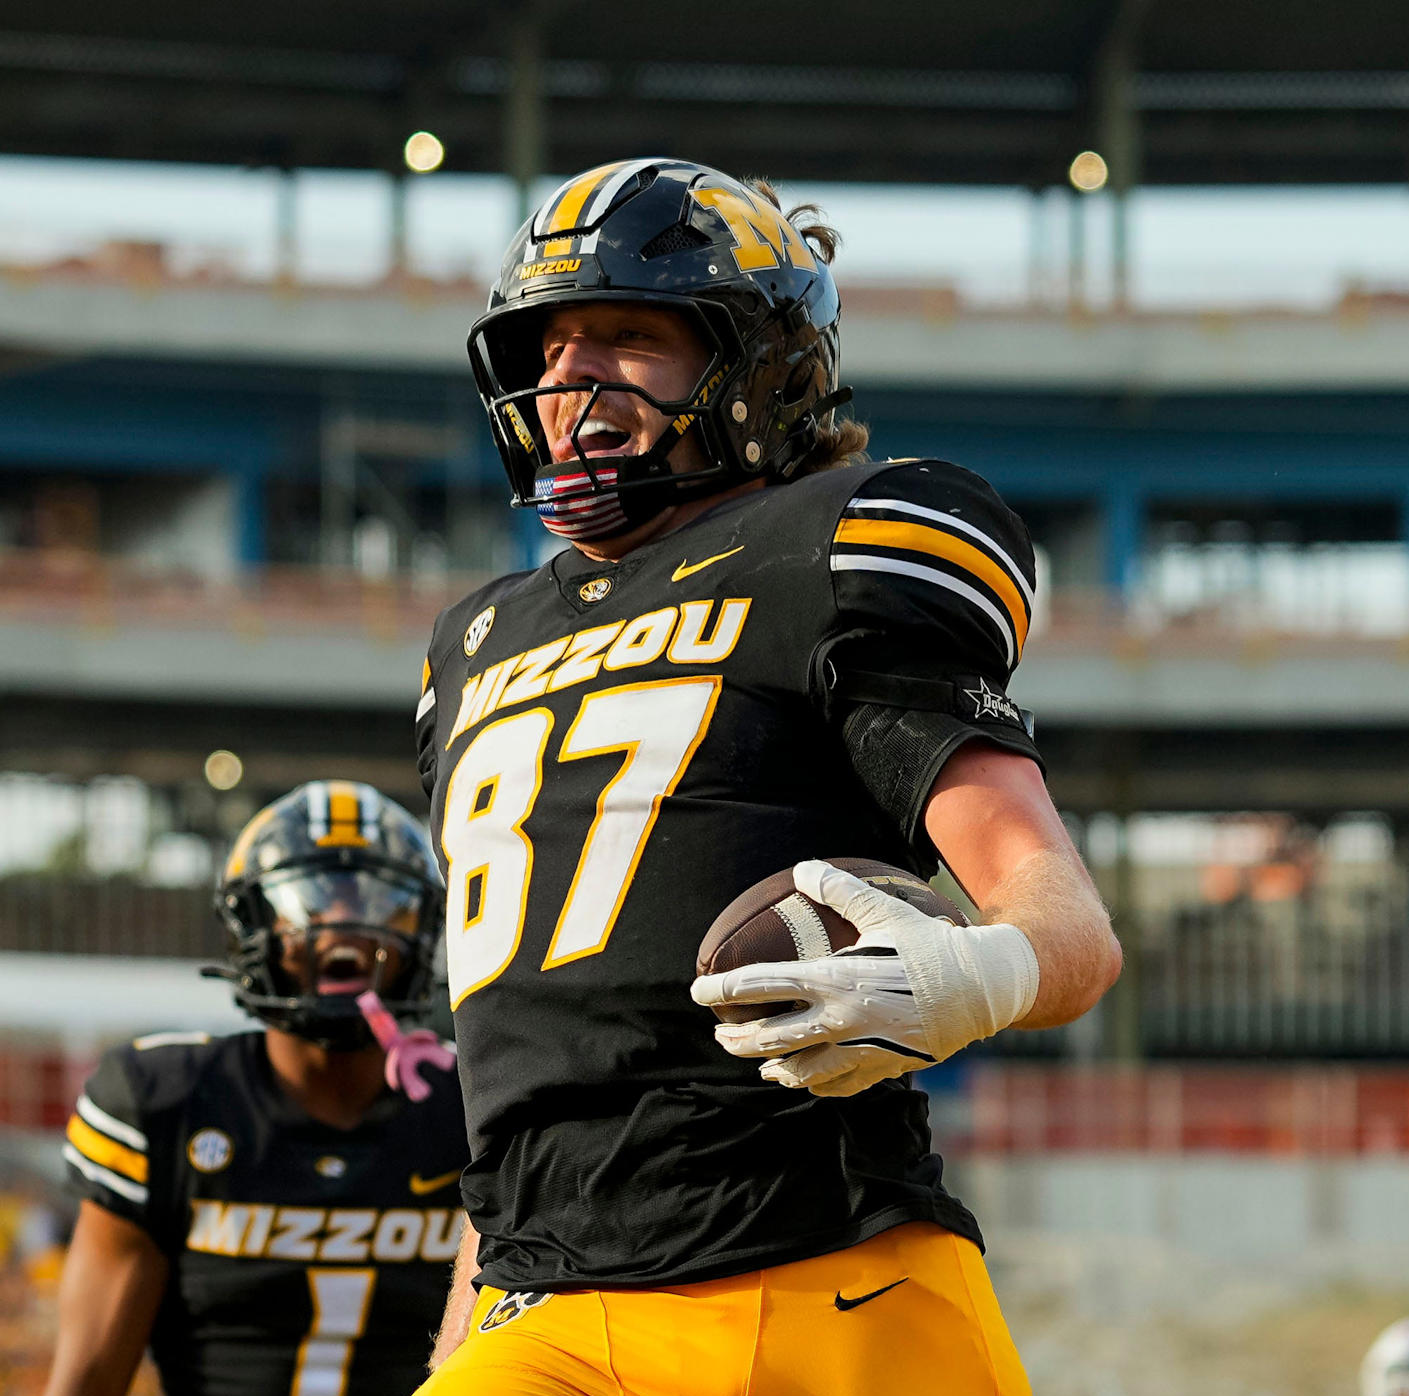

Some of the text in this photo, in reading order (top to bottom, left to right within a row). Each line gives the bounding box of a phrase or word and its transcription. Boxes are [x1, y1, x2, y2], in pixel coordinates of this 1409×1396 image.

[519, 259, 582, 280] MIZZOU
[688, 188, 819, 274] M
[445, 597, 752, 751] MIZZOU
[441, 674, 723, 1012] 87
[187, 1199, 465, 1262] MIZZOU
